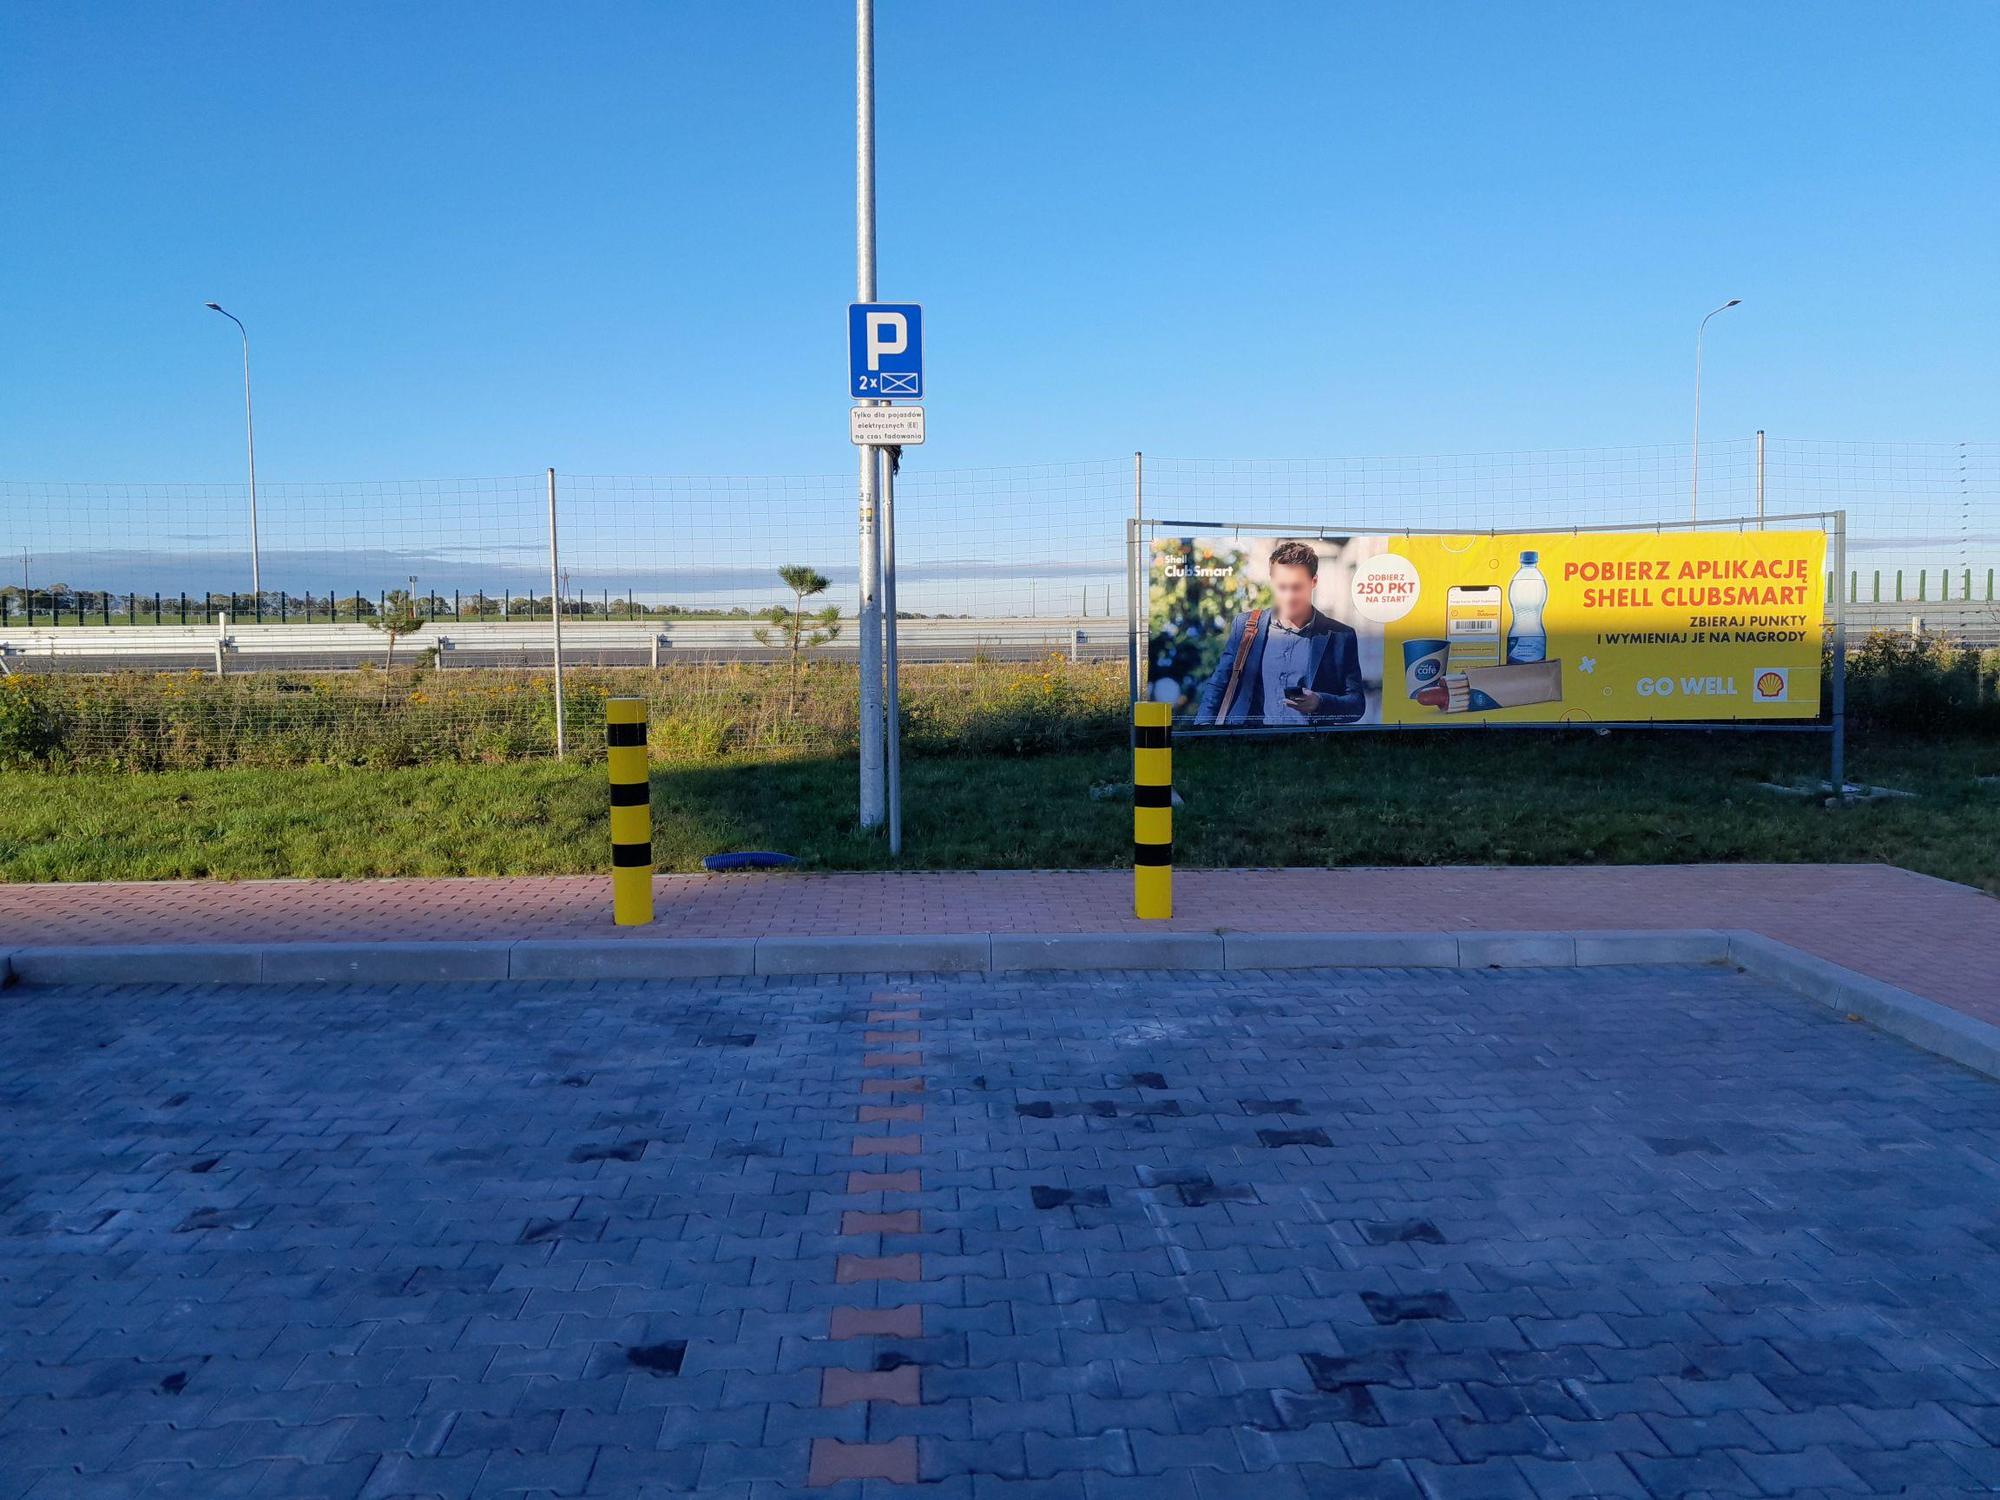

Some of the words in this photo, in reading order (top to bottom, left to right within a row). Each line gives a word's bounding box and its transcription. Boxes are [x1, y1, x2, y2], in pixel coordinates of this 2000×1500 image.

[866, 312, 908, 371] P
[853, 411, 871, 420] Tylko
[888, 411, 922, 420] pojazdów
[857, 422, 905, 430] elektrycznych
[884, 432, 922, 440] ładowania
[1164, 554, 1188, 564] Shell
[1164, 565, 1234, 577] ClubSmart
[1564, 561, 1671, 581] POBIERZ
[1677, 559, 1808, 583] APLIKACJĘ
[1367, 574, 1405, 582] ODBIERZ
[1356, 582, 1385, 595] 250
[1388, 582, 1415, 594] PKT
[1583, 588, 1654, 608] SHELL
[1660, 586, 1808, 607] CLUBSMART
[1689, 615, 1746, 628] ZBIERAJ
[1749, 614, 1808, 627] PUNKTY
[1596, 633, 1602, 645] I
[1605, 632, 1688, 645] WYMIENIAJ
[1691, 632, 1706, 644] JE
[1709, 631, 1731, 643] NA
[1734, 630, 1808, 643] NAGRODY
[1636, 676, 1675, 697] GO
[1679, 676, 1738, 696] WELL
